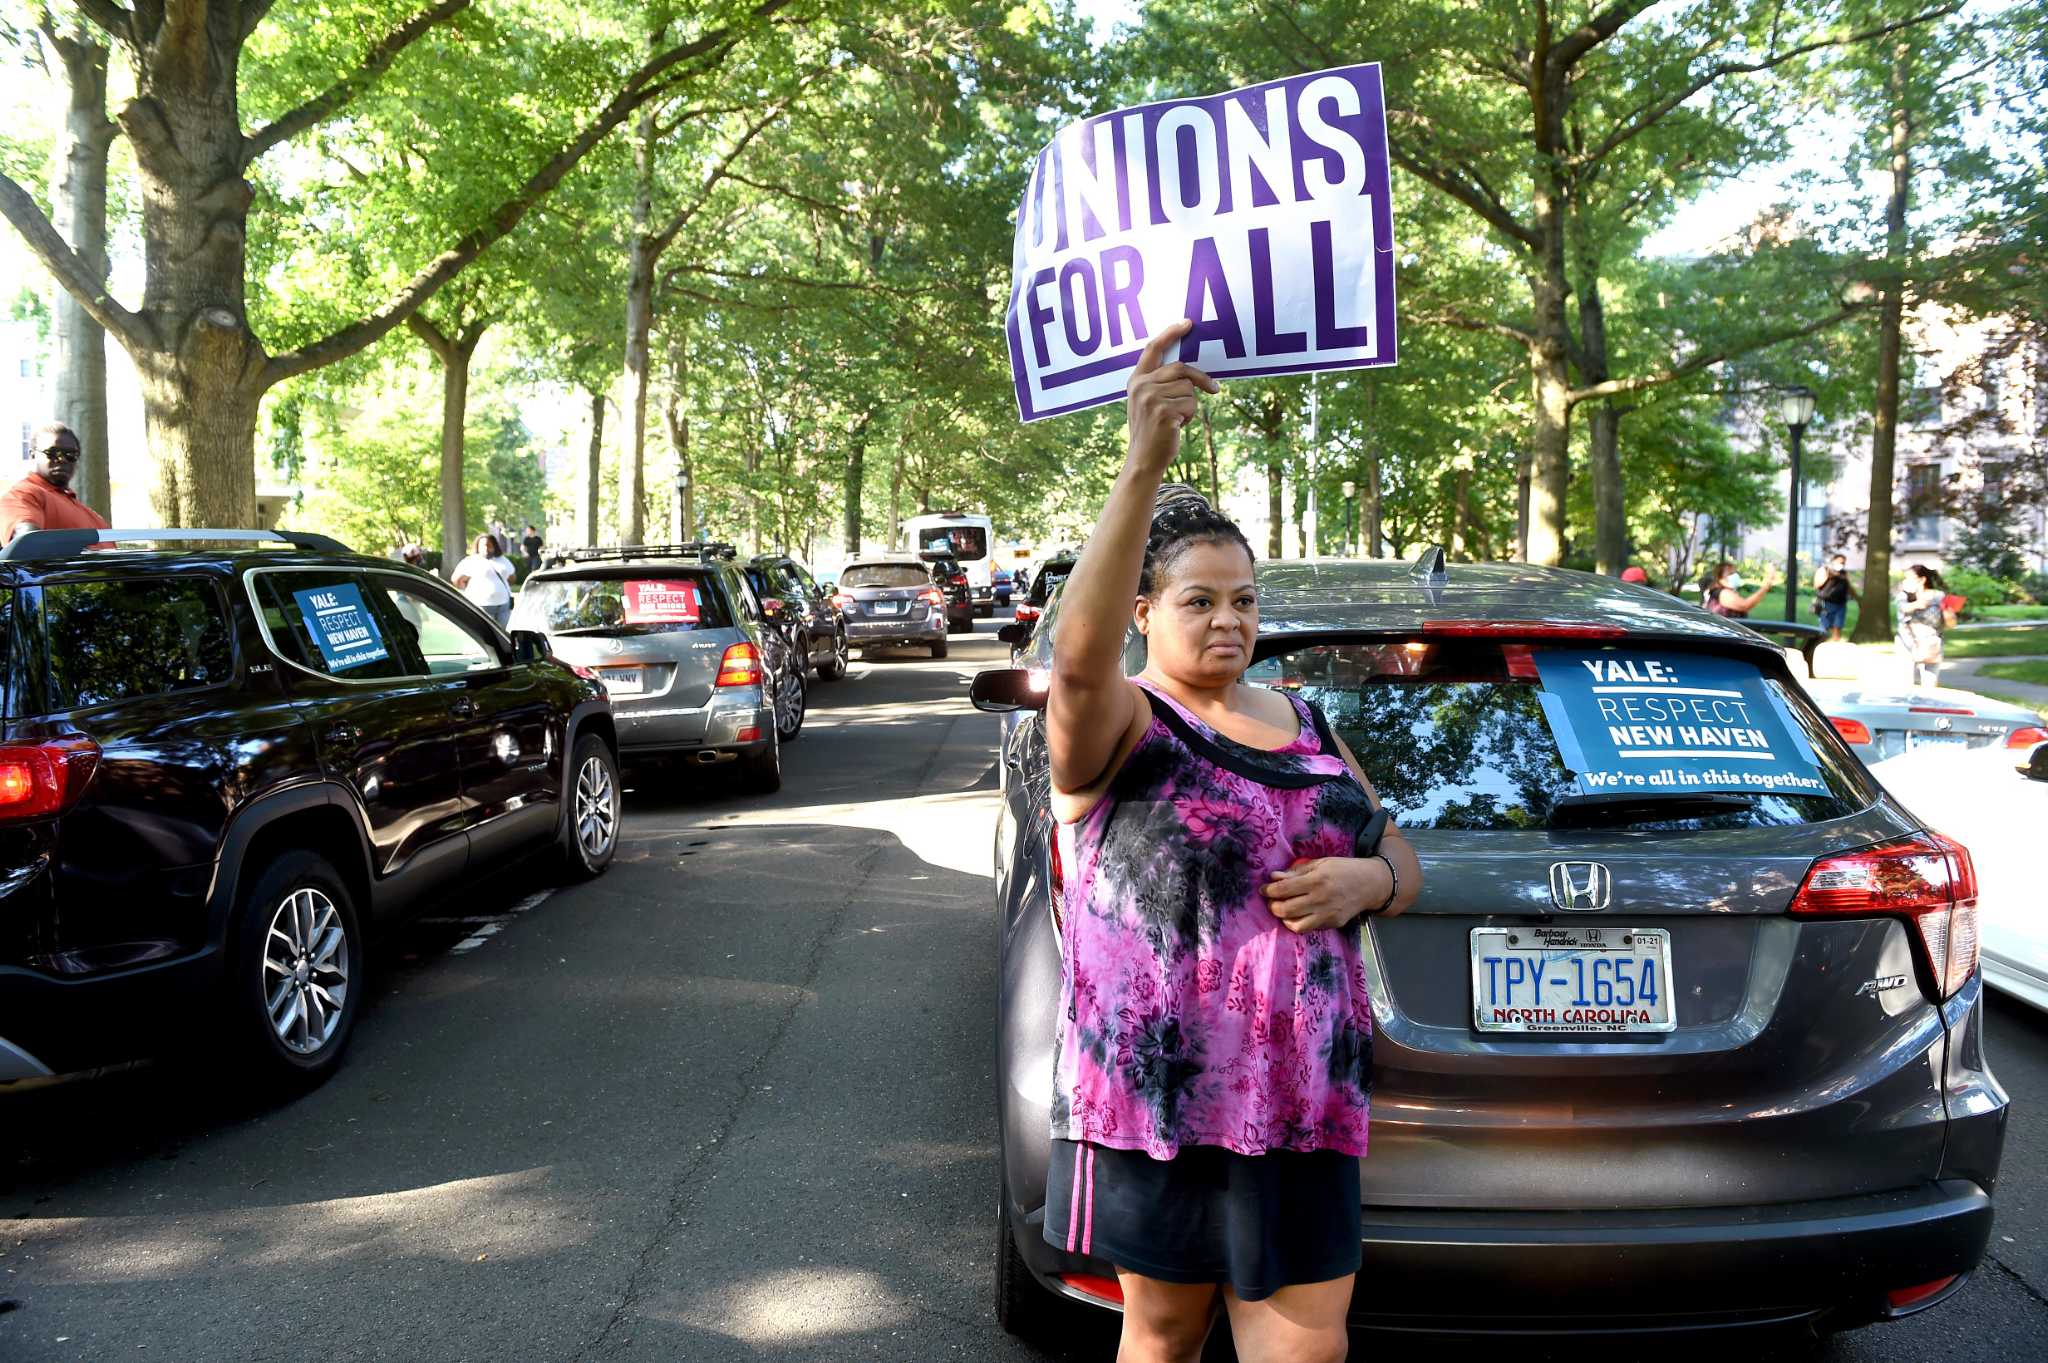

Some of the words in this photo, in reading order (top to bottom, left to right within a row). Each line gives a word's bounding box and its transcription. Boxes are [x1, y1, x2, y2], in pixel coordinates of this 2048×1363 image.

[1024, 76, 1366, 262] UNIONS
[1026, 245, 1149, 369] FOR
[1179, 220, 1368, 362] ALL
[309, 592, 339, 610] YALE:
[638, 594, 685, 603] RESPECT
[319, 611, 362, 632] RESPECT
[326, 631, 346, 645] NEW
[344, 626, 370, 642] HAVEN
[1582, 660, 1679, 683] YALE:
[1597, 698, 1750, 724] RESPECT
[1608, 726, 1673, 746] NEW
[1678, 726, 1769, 748] HAVEN
[1584, 771, 1645, 787] We're
[1648, 769, 1675, 786] all
[1678, 770, 1700, 785] in
[1702, 769, 1740, 785] this
[1744, 772, 1825, 790] together.
[1534, 929, 1569, 938] Barbour
[1544, 937, 1578, 948] Hendrick
[1483, 957, 1658, 1007] TPY-1654
[1855, 975, 1908, 998] AWD
[1493, 1008, 1556, 1023] NORTH
[1562, 1009, 1651, 1023] CAROLINA
